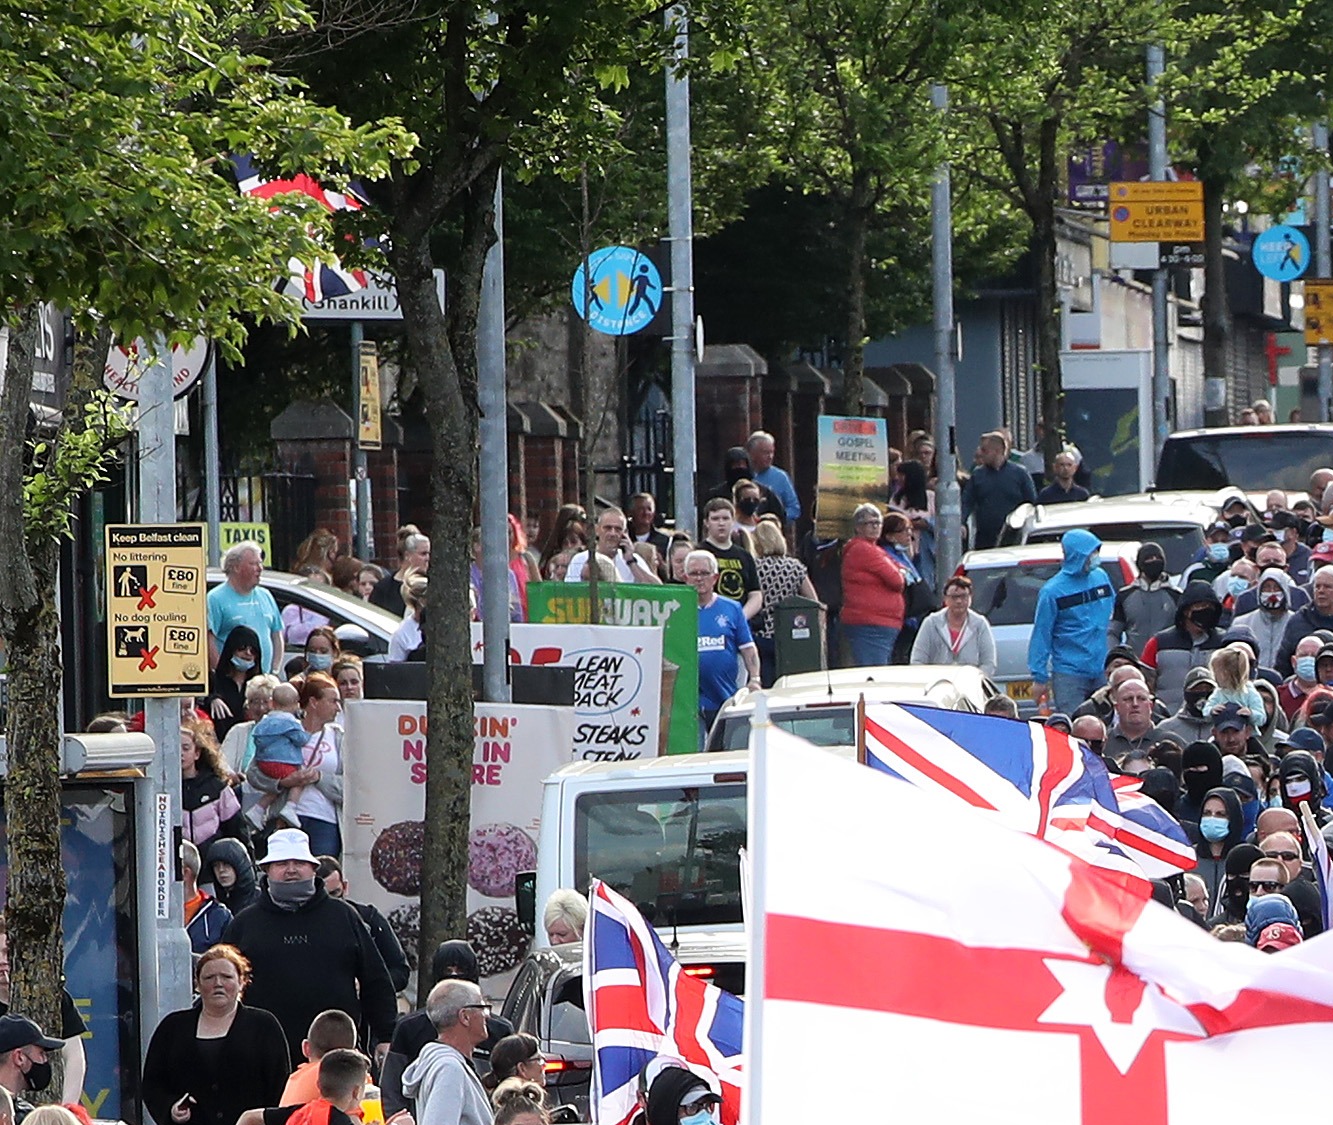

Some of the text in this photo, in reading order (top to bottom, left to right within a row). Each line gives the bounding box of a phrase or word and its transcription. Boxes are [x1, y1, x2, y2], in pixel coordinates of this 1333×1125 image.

[1145, 206, 1189, 214] URBAN
[1132, 220, 1198, 228] CLEARWAY
[838, 438, 874, 448] GOSPEL
[836, 451, 876, 462] MEETING
[112, 532, 199, 544] Keep Belfast clean
[224, 528, 265, 544] TAXIS
[113, 552, 168, 562] No littering
[168, 569, 194, 581] £80
[542, 597, 681, 626] SUWAY
[114, 613, 186, 623] No dog fouling
[169, 630, 195, 642] £80
[575, 656, 624, 673] LEAN
[574, 689, 624, 708] PACK
[574, 724, 649, 745] STEAKS
[482, 742, 511, 764] IN
[410, 764, 502, 785] SRE
[284, 935, 308, 944] MAN
